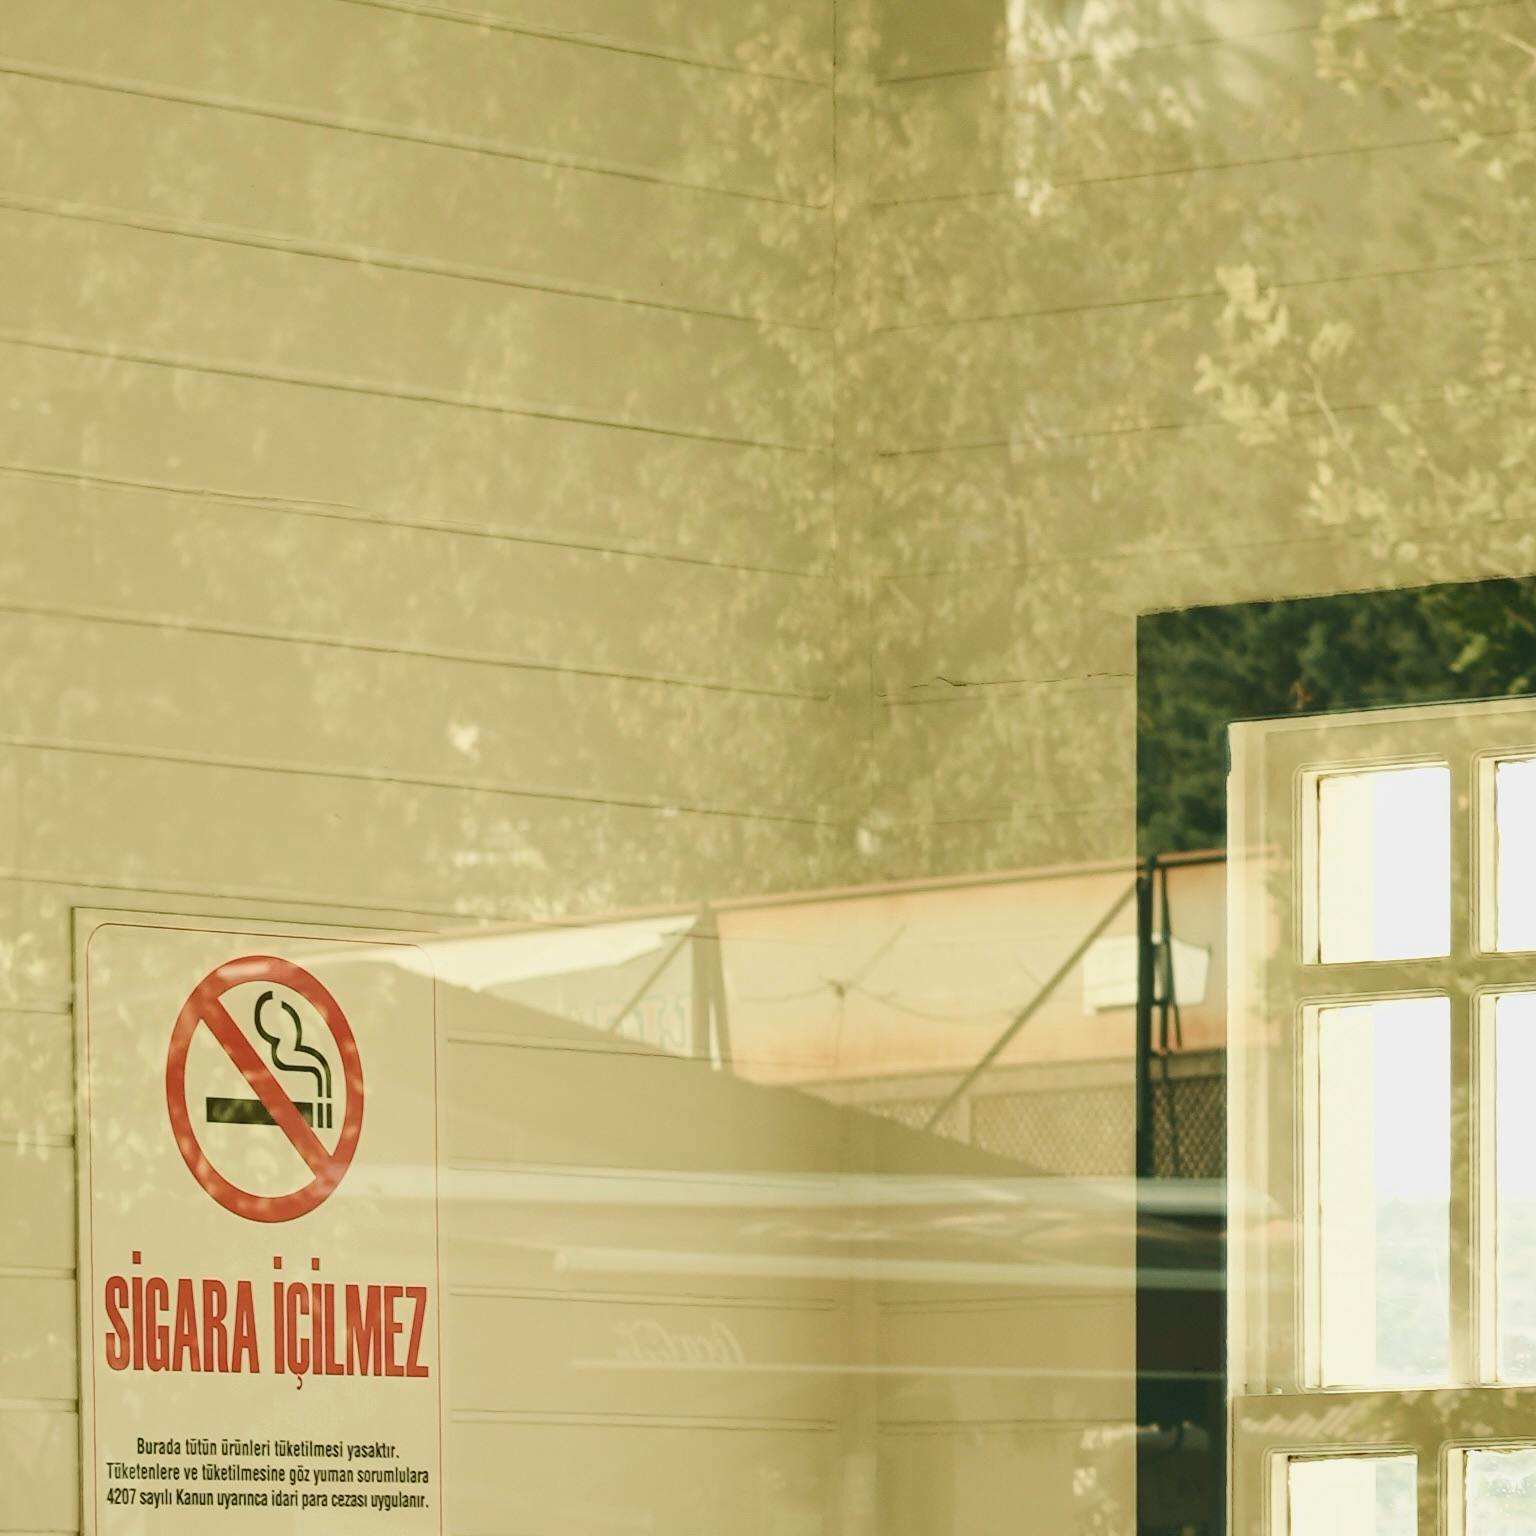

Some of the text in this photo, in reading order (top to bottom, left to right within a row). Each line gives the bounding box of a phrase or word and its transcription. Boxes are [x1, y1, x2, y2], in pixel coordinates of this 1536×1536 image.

[105, 1251, 429, 1390] SİGARA İÇİLMEZ
[136, 1437, 400, 1461] Burada tütün ürünleri tüketilmesi yasaktır.
[106, 1462, 429, 1487] Tüketenlere ve tüketilmesine göz yuman sorumlulara
[106, 1488, 429, 1512] 4207 sayılı Kanun uyarınca idari para cezası uygulanır.
